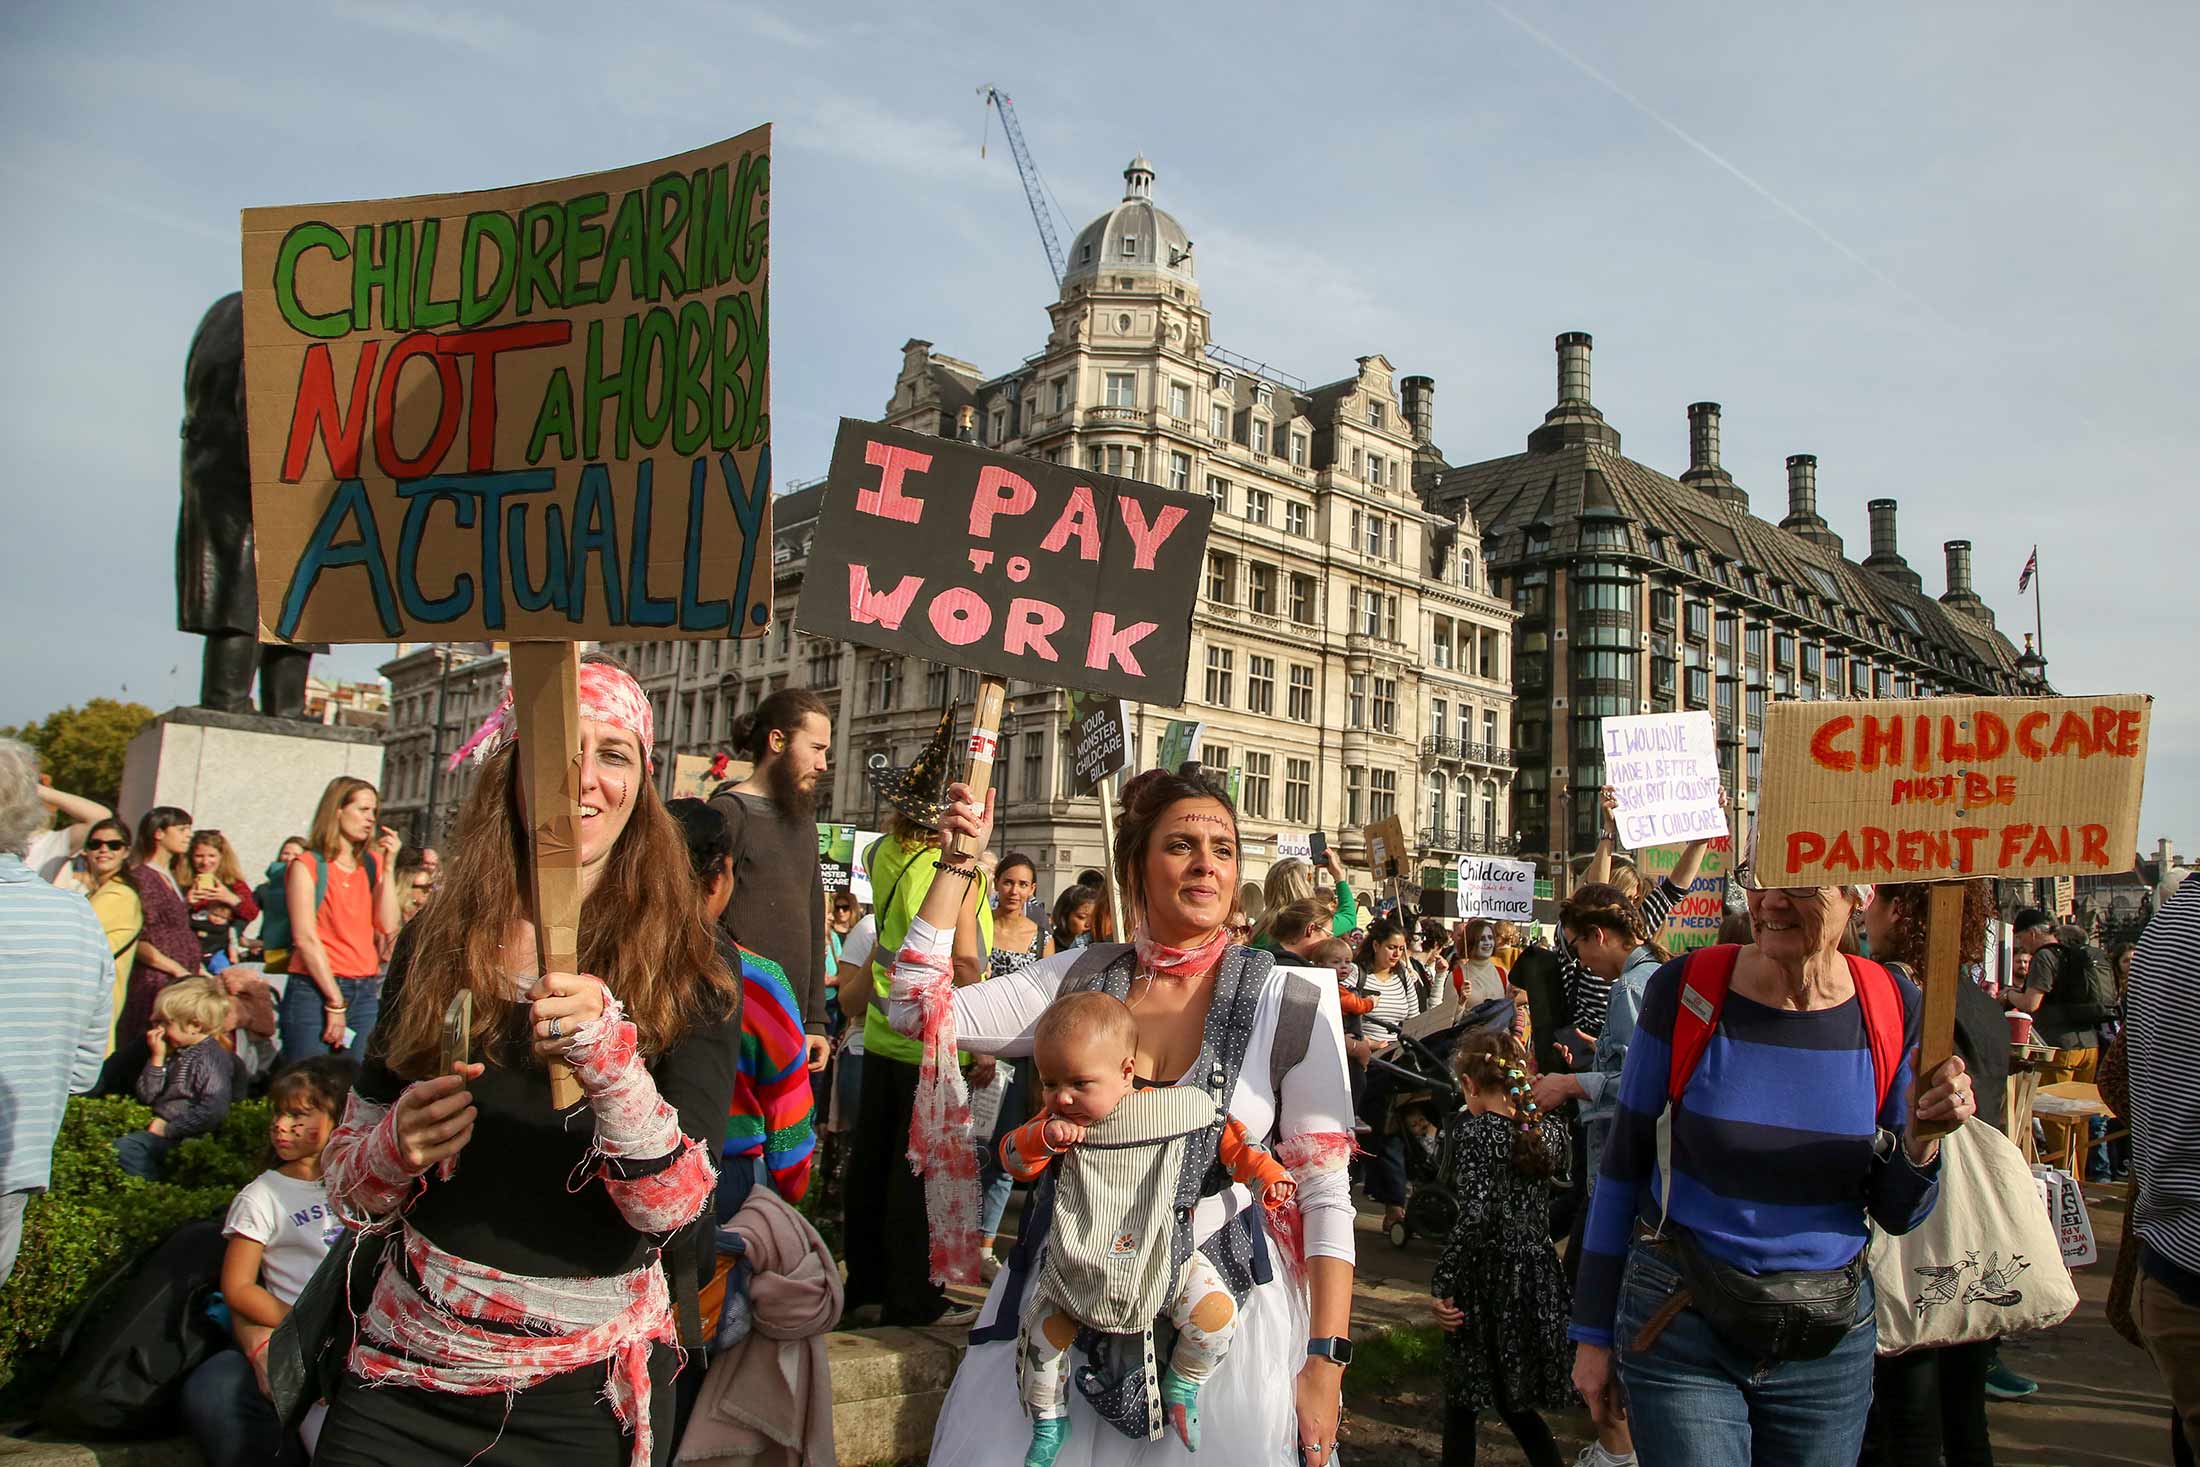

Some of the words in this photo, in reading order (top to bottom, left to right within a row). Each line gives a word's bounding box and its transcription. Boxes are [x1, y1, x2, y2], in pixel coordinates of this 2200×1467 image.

[281, 320, 571, 484] NOT
[526, 367, 576, 464] A
[855, 440, 934, 524] I
[968, 465, 1189, 570] PAY
[275, 443, 771, 639] ACTUALLY.
[968, 548, 1031, 583] TO
[847, 563, 1160, 677] WORK
[1081, 710, 1105, 736] YOUR
[1076, 720, 1116, 759] MONSTER
[1076, 734, 1122, 776] CHILDCARE
[1607, 729, 1622, 757] I
[1809, 705, 2142, 774] CHILDCARE
[1090, 761, 1109, 783] BILL
[1610, 761, 1643, 785] MADE
[1646, 762, 1653, 779] A
[1655, 759, 1698, 778] BETTER
[1646, 780, 1667, 804] BUT
[1669, 780, 1674, 801] I
[1891, 774, 1960, 806] MUST
[1961, 771, 2018, 811] BE
[1626, 814, 1657, 842] GET
[1662, 807, 1722, 837] CHILDCARE
[1278, 845, 1311, 856] CHILDCA
[1707, 836, 1733, 853] ORK
[1785, 826, 1990, 874] PARENT
[1998, 822, 2111, 870] FAIR
[820, 863, 839, 871] OUR
[822, 878, 849, 886] DCARE
[1460, 859, 1526, 882] Childcare
[1681, 916, 1721, 928] NEEDS
